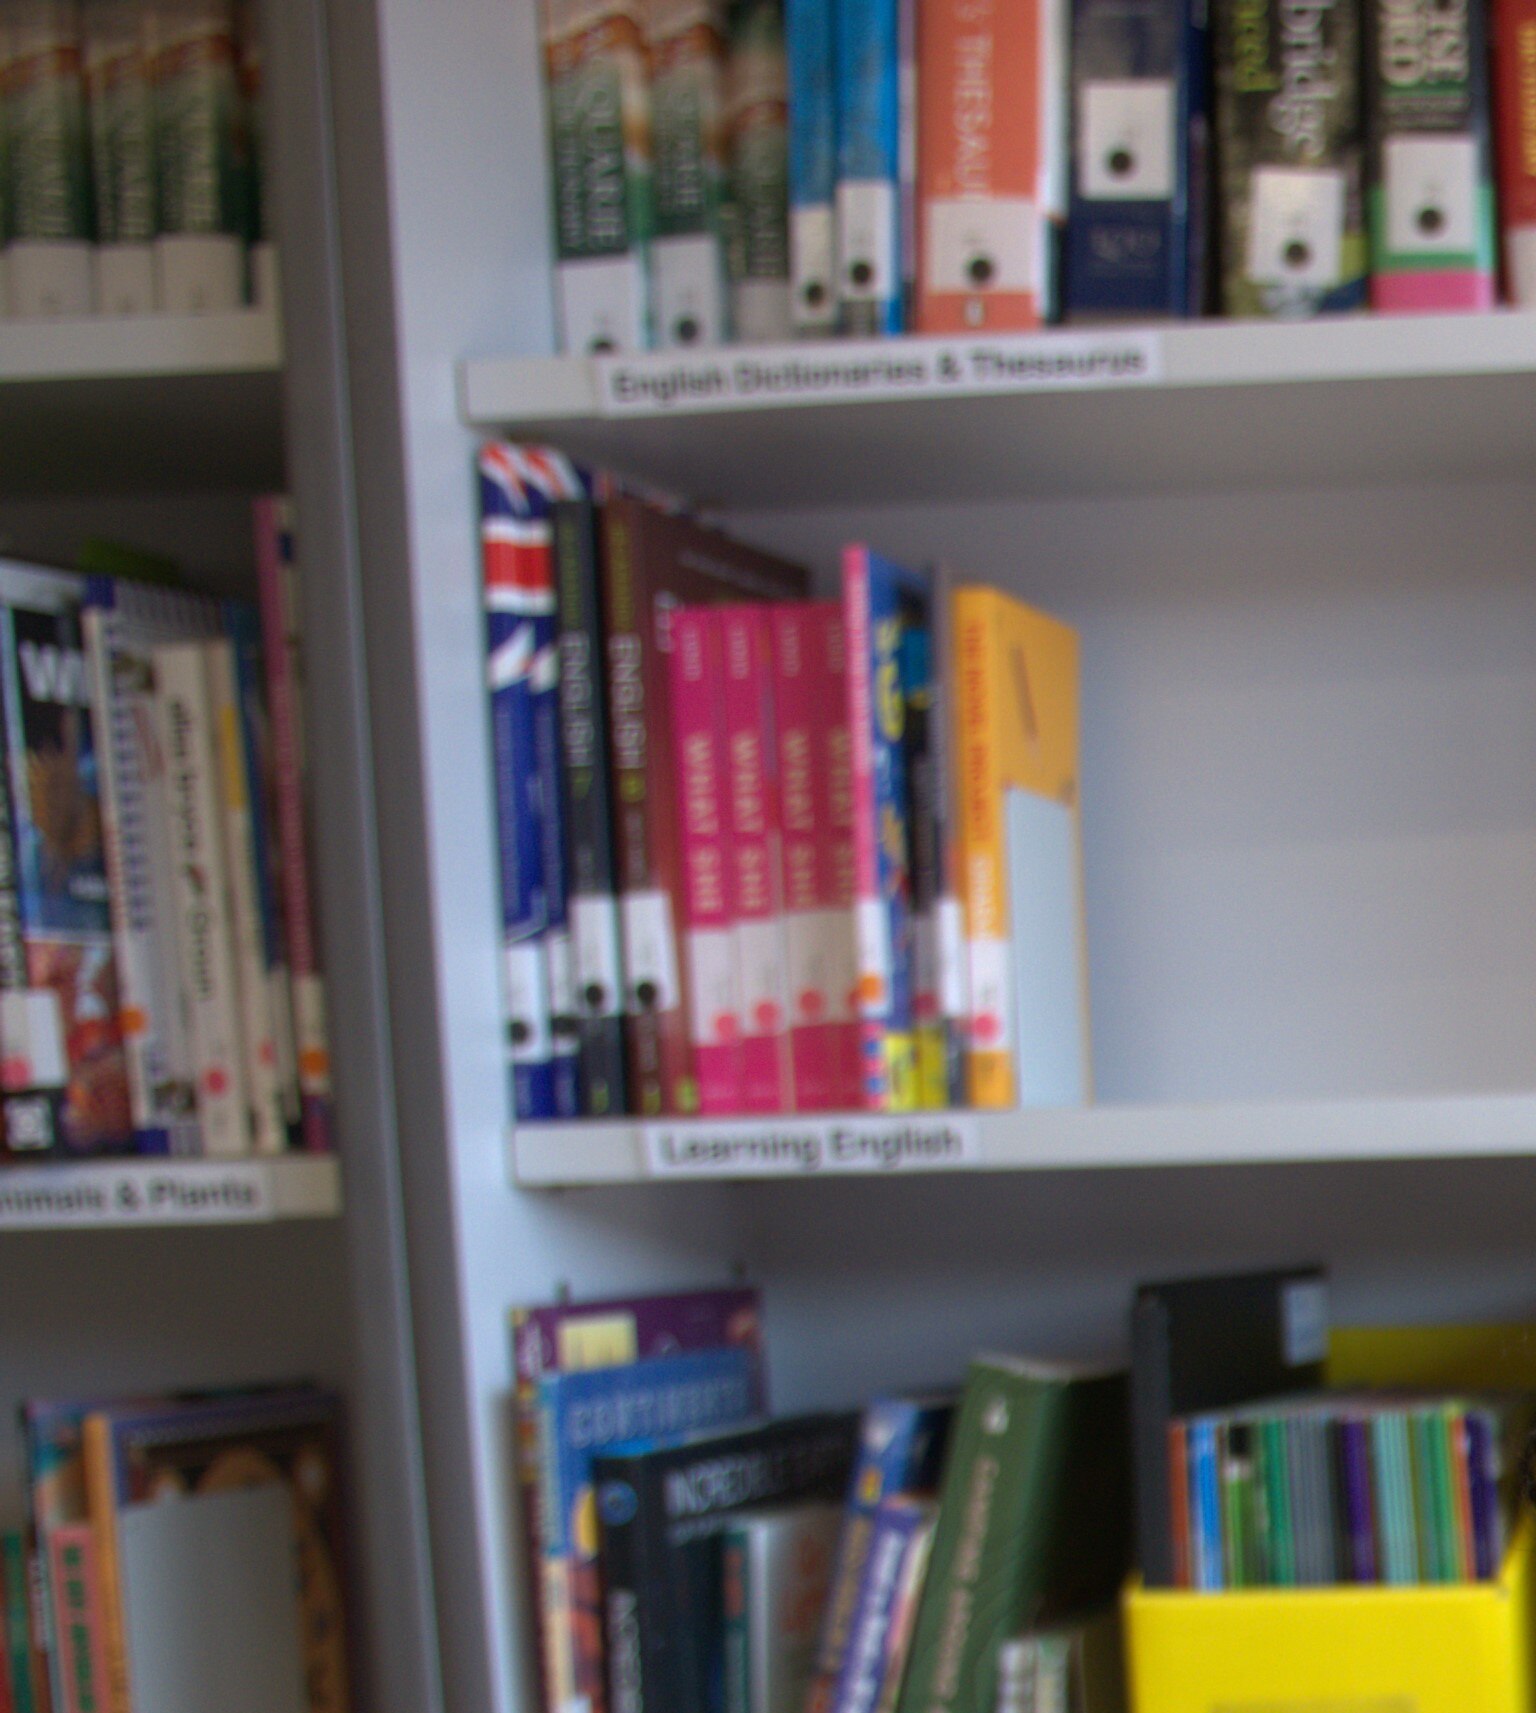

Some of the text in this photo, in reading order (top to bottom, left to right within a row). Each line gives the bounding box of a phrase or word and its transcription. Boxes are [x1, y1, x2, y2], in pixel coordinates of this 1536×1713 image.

[612, 346, 1146, 404] English Dictionaries & Thesaurus
[659, 1125, 962, 1172] Learning English
[116, 1173, 144, 1210] &
[149, 1173, 258, 1208] Plants
